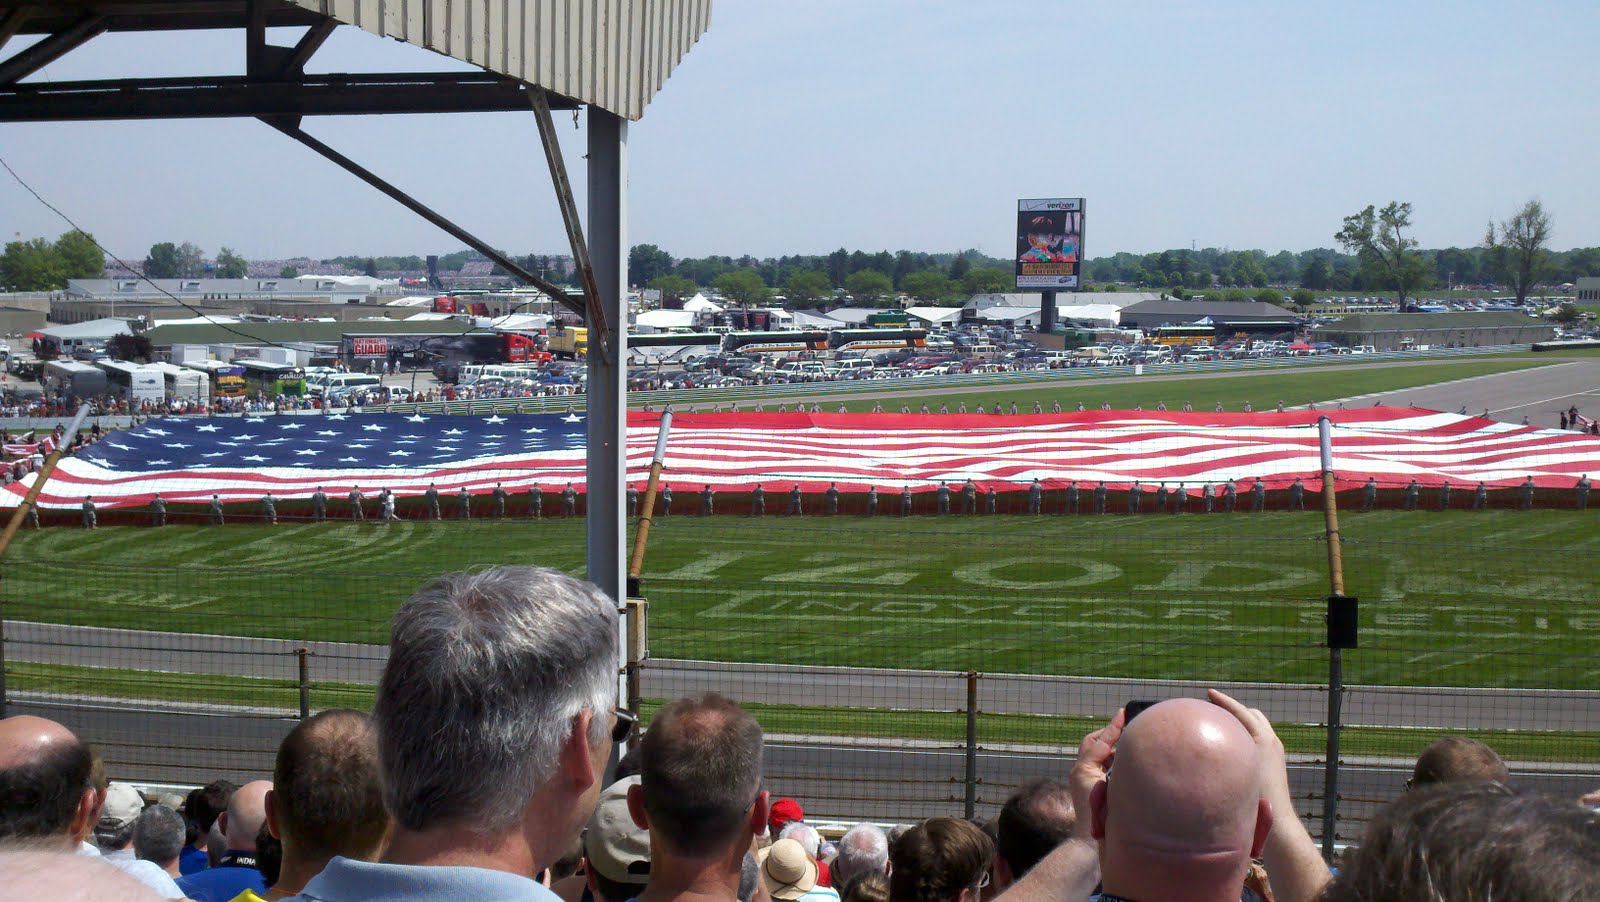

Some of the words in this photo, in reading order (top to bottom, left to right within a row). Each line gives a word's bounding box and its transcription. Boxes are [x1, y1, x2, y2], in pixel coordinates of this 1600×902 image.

[354, 344, 387, 354] GUARD
[640, 550, 1325, 592] IZOD
[769, 599, 1233, 621] INDYCAR
